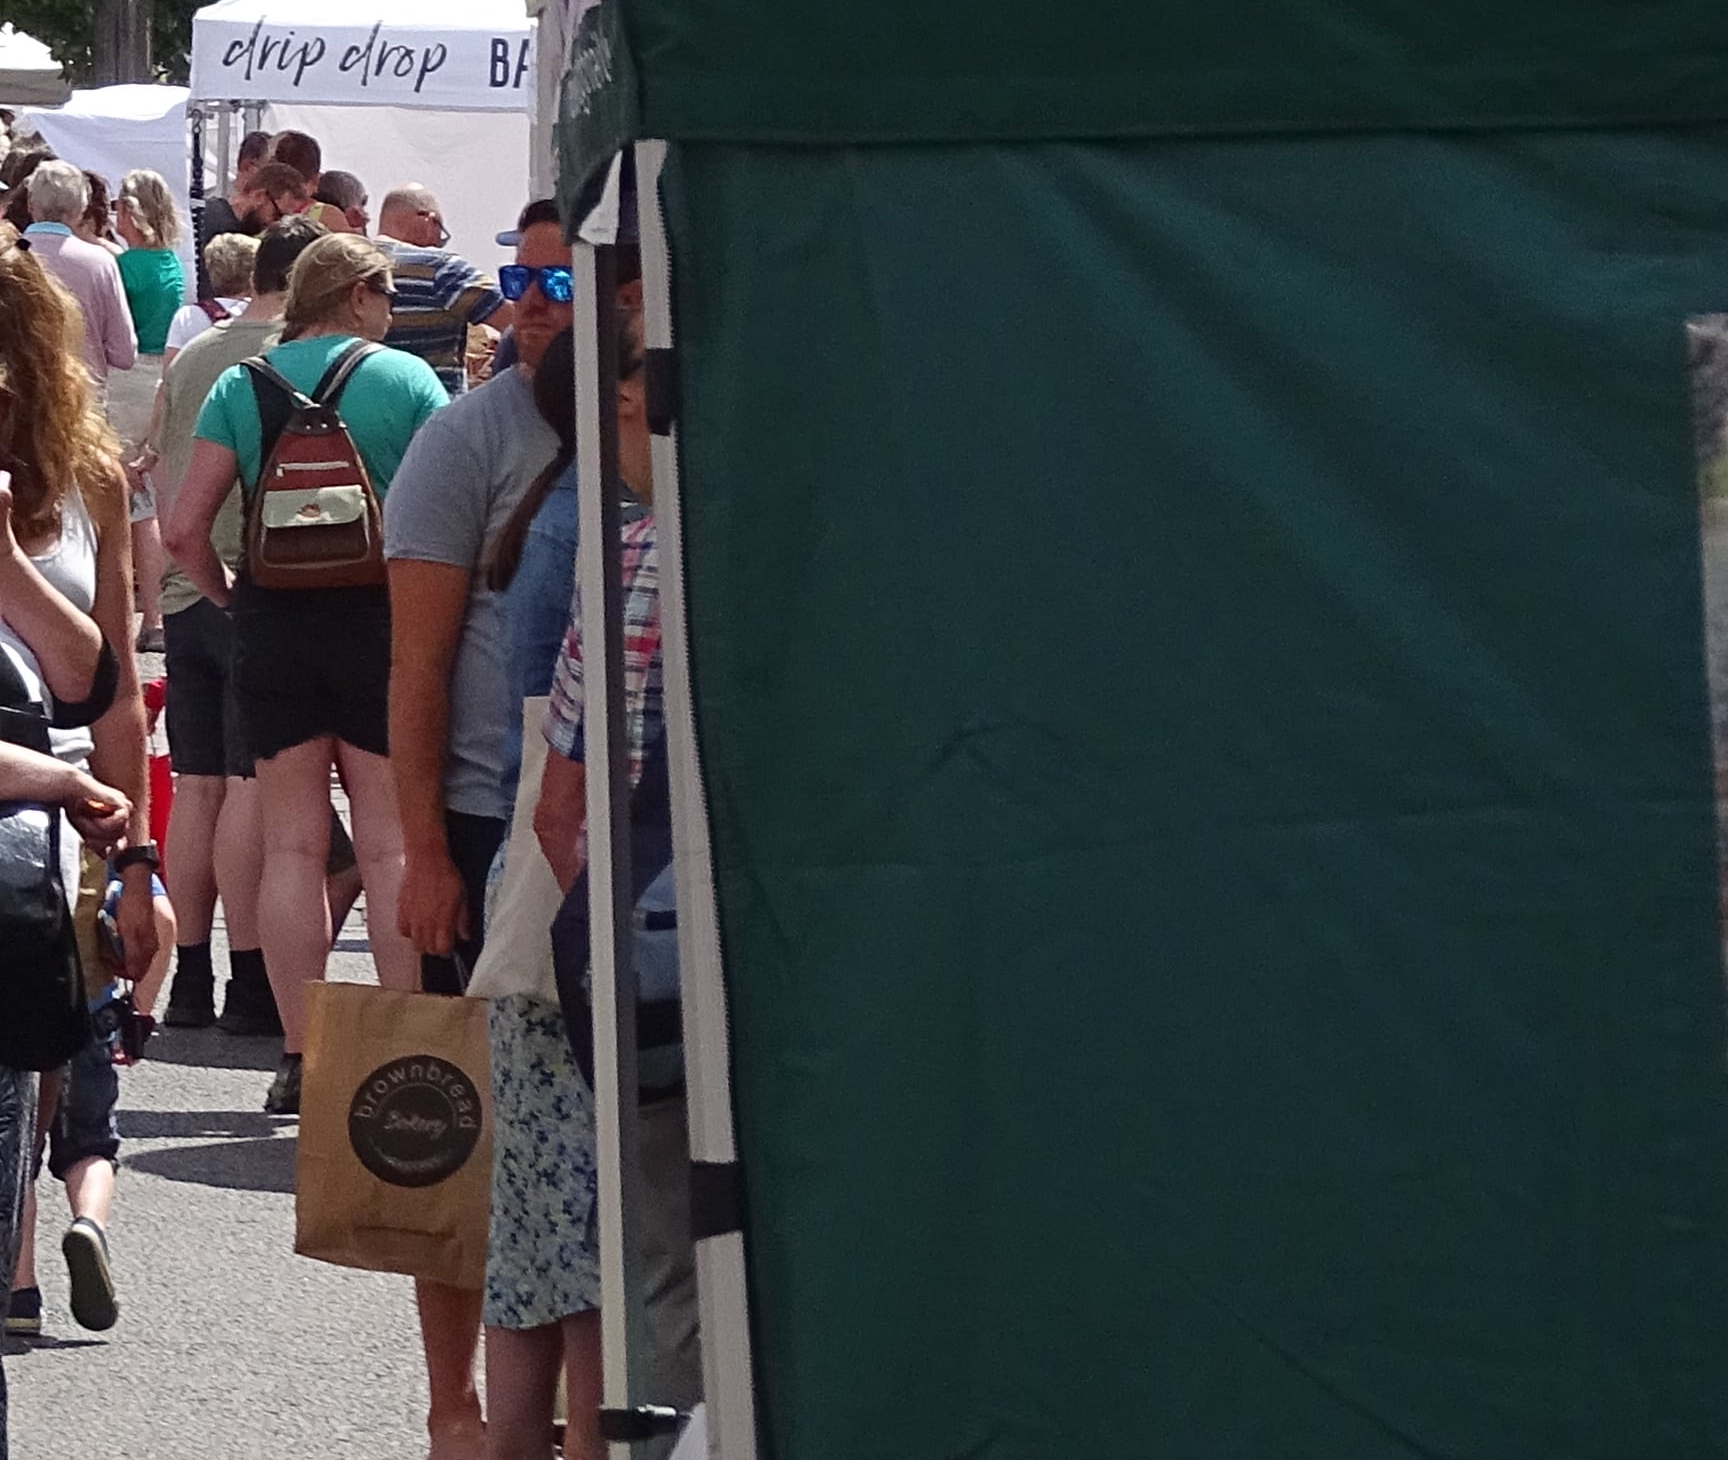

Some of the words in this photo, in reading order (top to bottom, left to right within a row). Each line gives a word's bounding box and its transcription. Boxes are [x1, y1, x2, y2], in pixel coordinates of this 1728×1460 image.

[221, 15, 327, 87] drip
[338, 19, 448, 93] drop
[354, 1062, 478, 1131] brownbread
